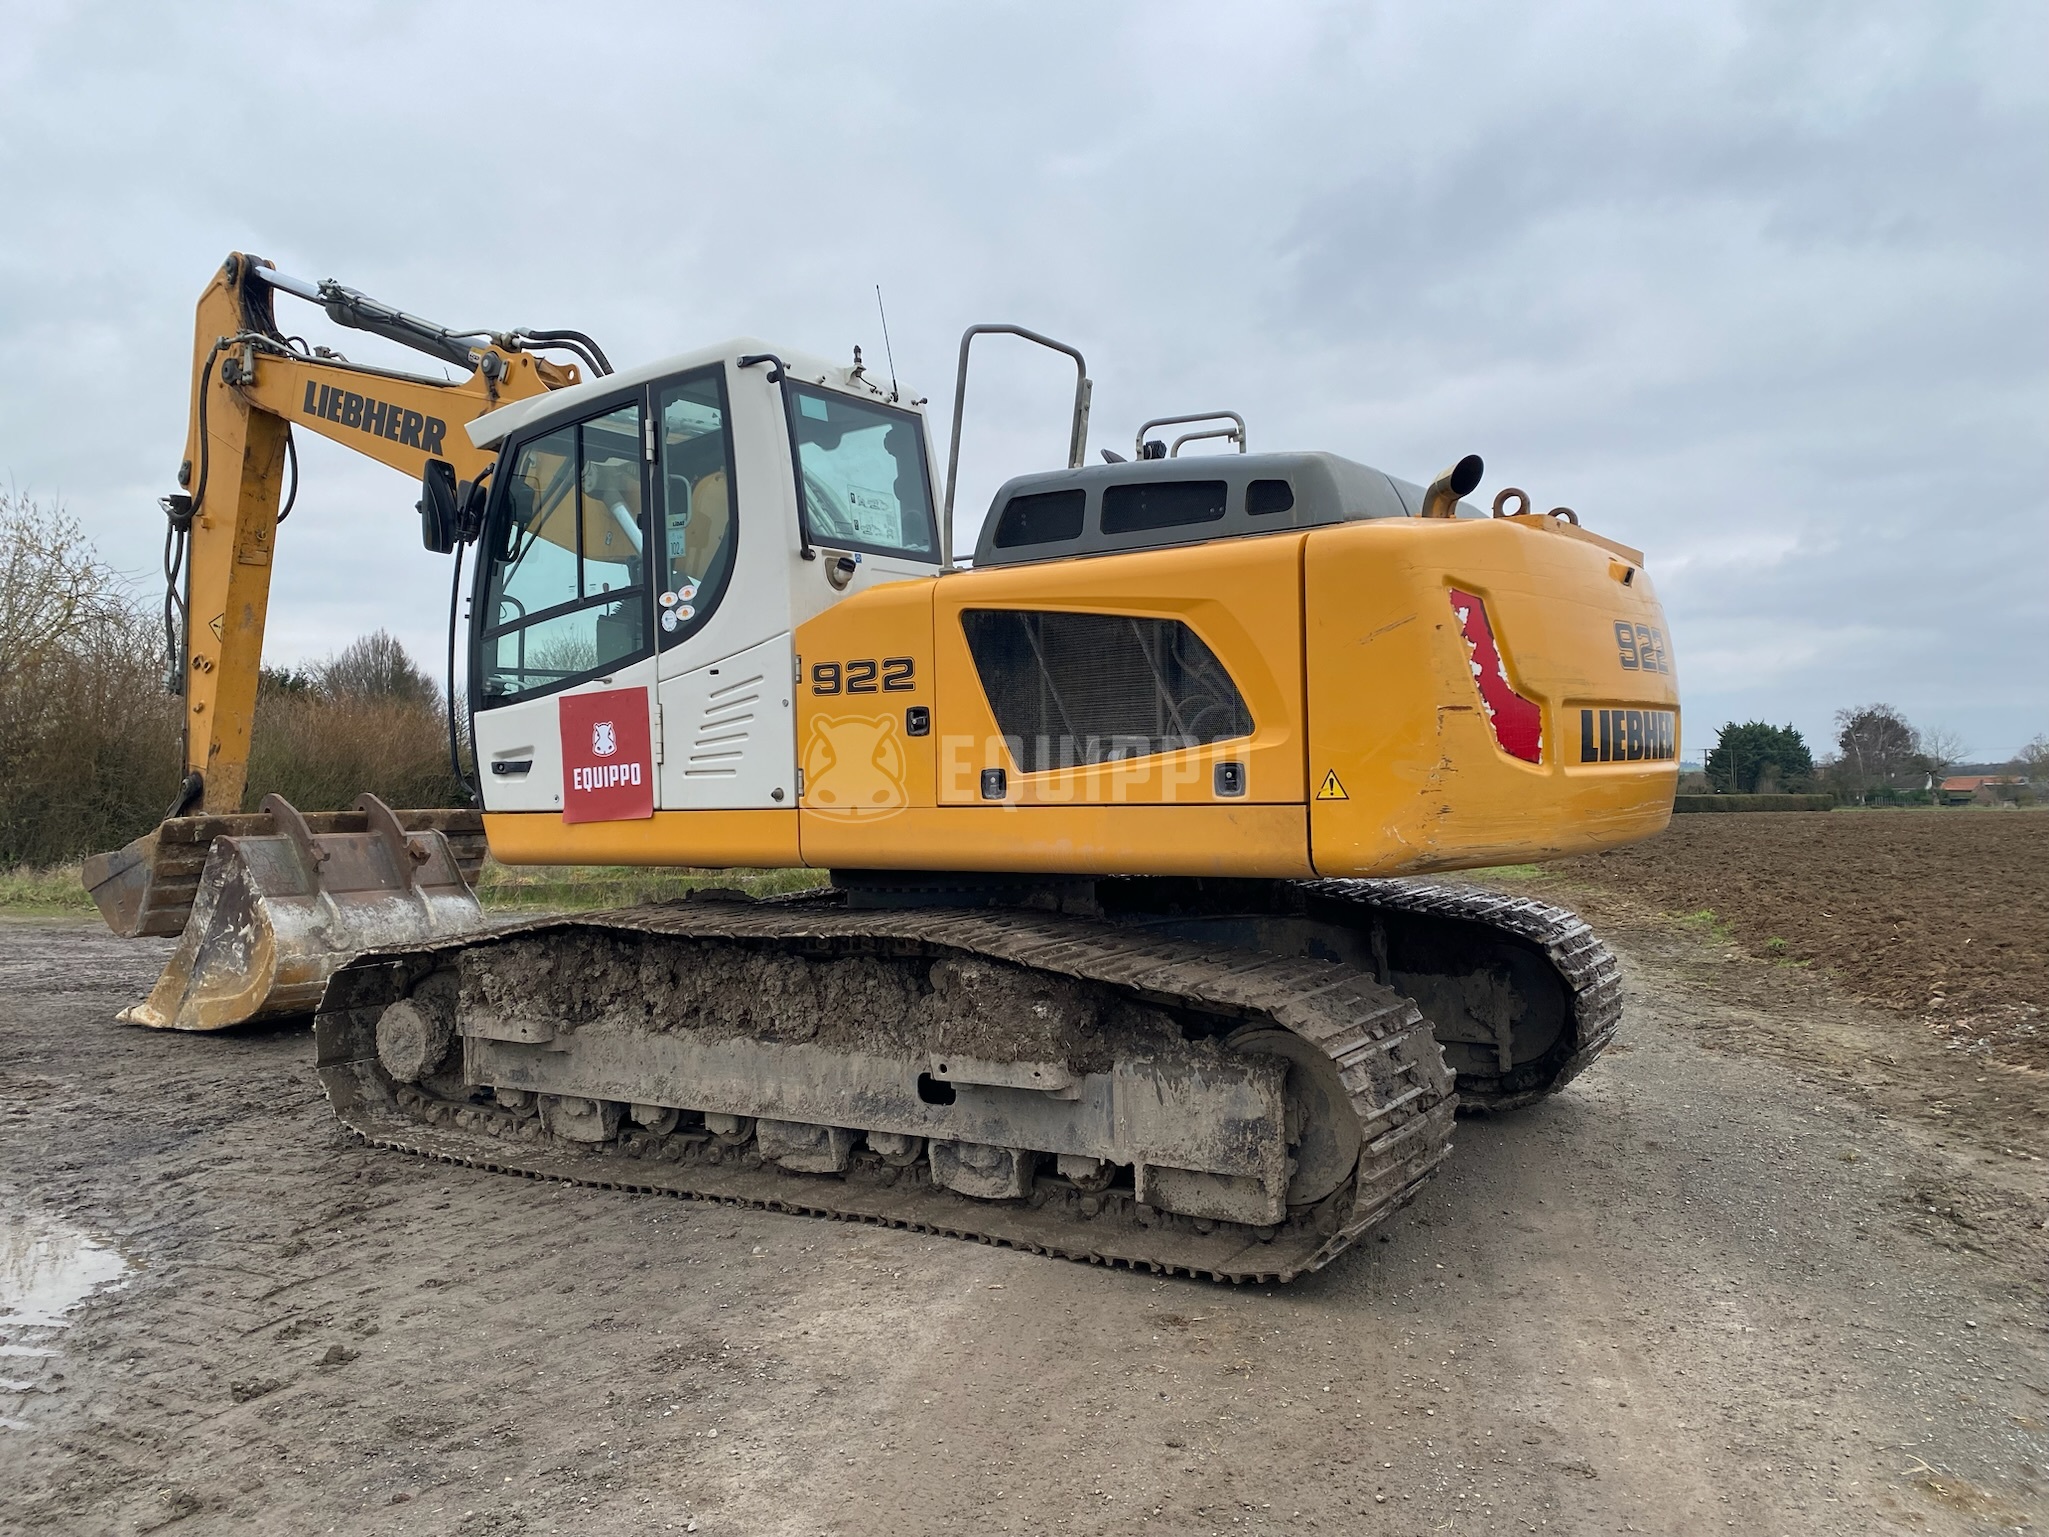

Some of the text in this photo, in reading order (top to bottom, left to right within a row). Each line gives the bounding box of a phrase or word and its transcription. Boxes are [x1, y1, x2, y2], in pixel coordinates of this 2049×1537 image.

[303, 380, 447, 456] LIEBHERR
[1613, 619, 1669, 675] 922
[811, 656, 916, 696] 922
[573, 763, 641, 792] EQUIPPO
